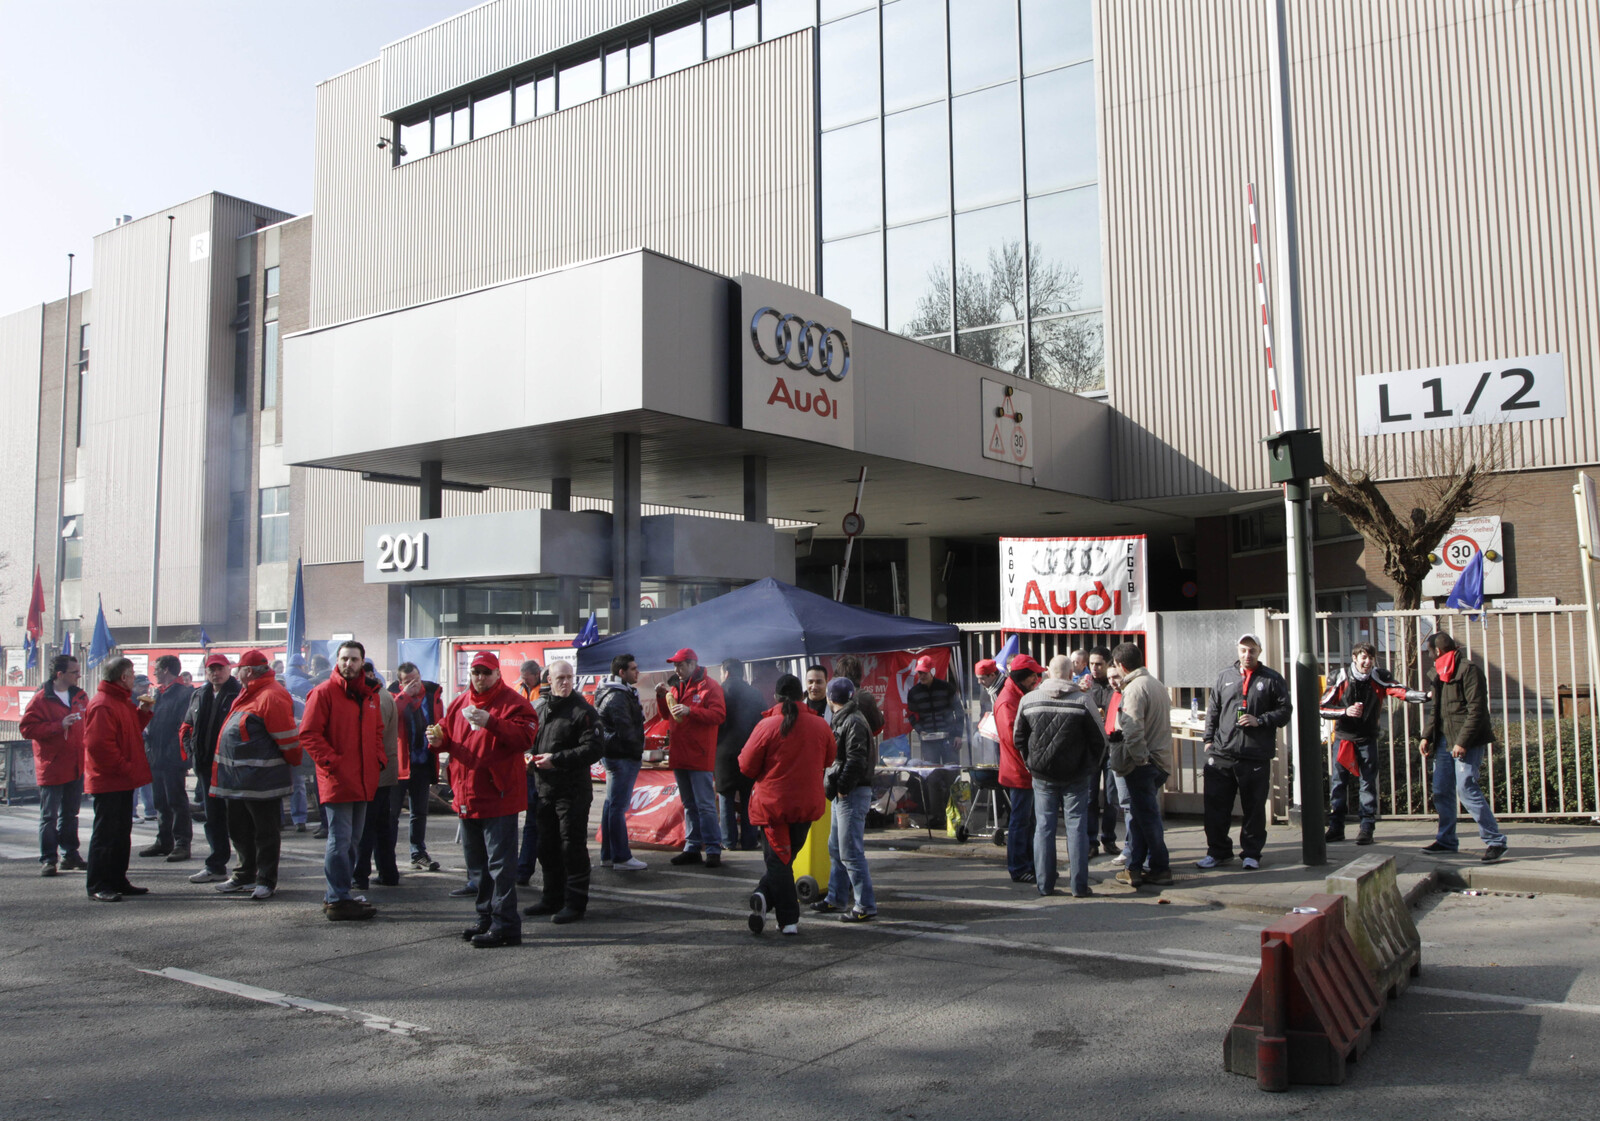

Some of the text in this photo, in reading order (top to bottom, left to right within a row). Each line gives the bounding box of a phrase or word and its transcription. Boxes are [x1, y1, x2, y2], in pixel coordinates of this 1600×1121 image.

[194, 239, 205, 256] R
[767, 376, 838, 420] Audi
[1379, 368, 1540, 423] L1/2
[1014, 434, 1024, 448] 30
[377, 531, 429, 572] 201
[1451, 545, 1471, 559] 30
[1022, 580, 1121, 616] Audi
[1029, 617, 1112, 630] BRUSSELS
